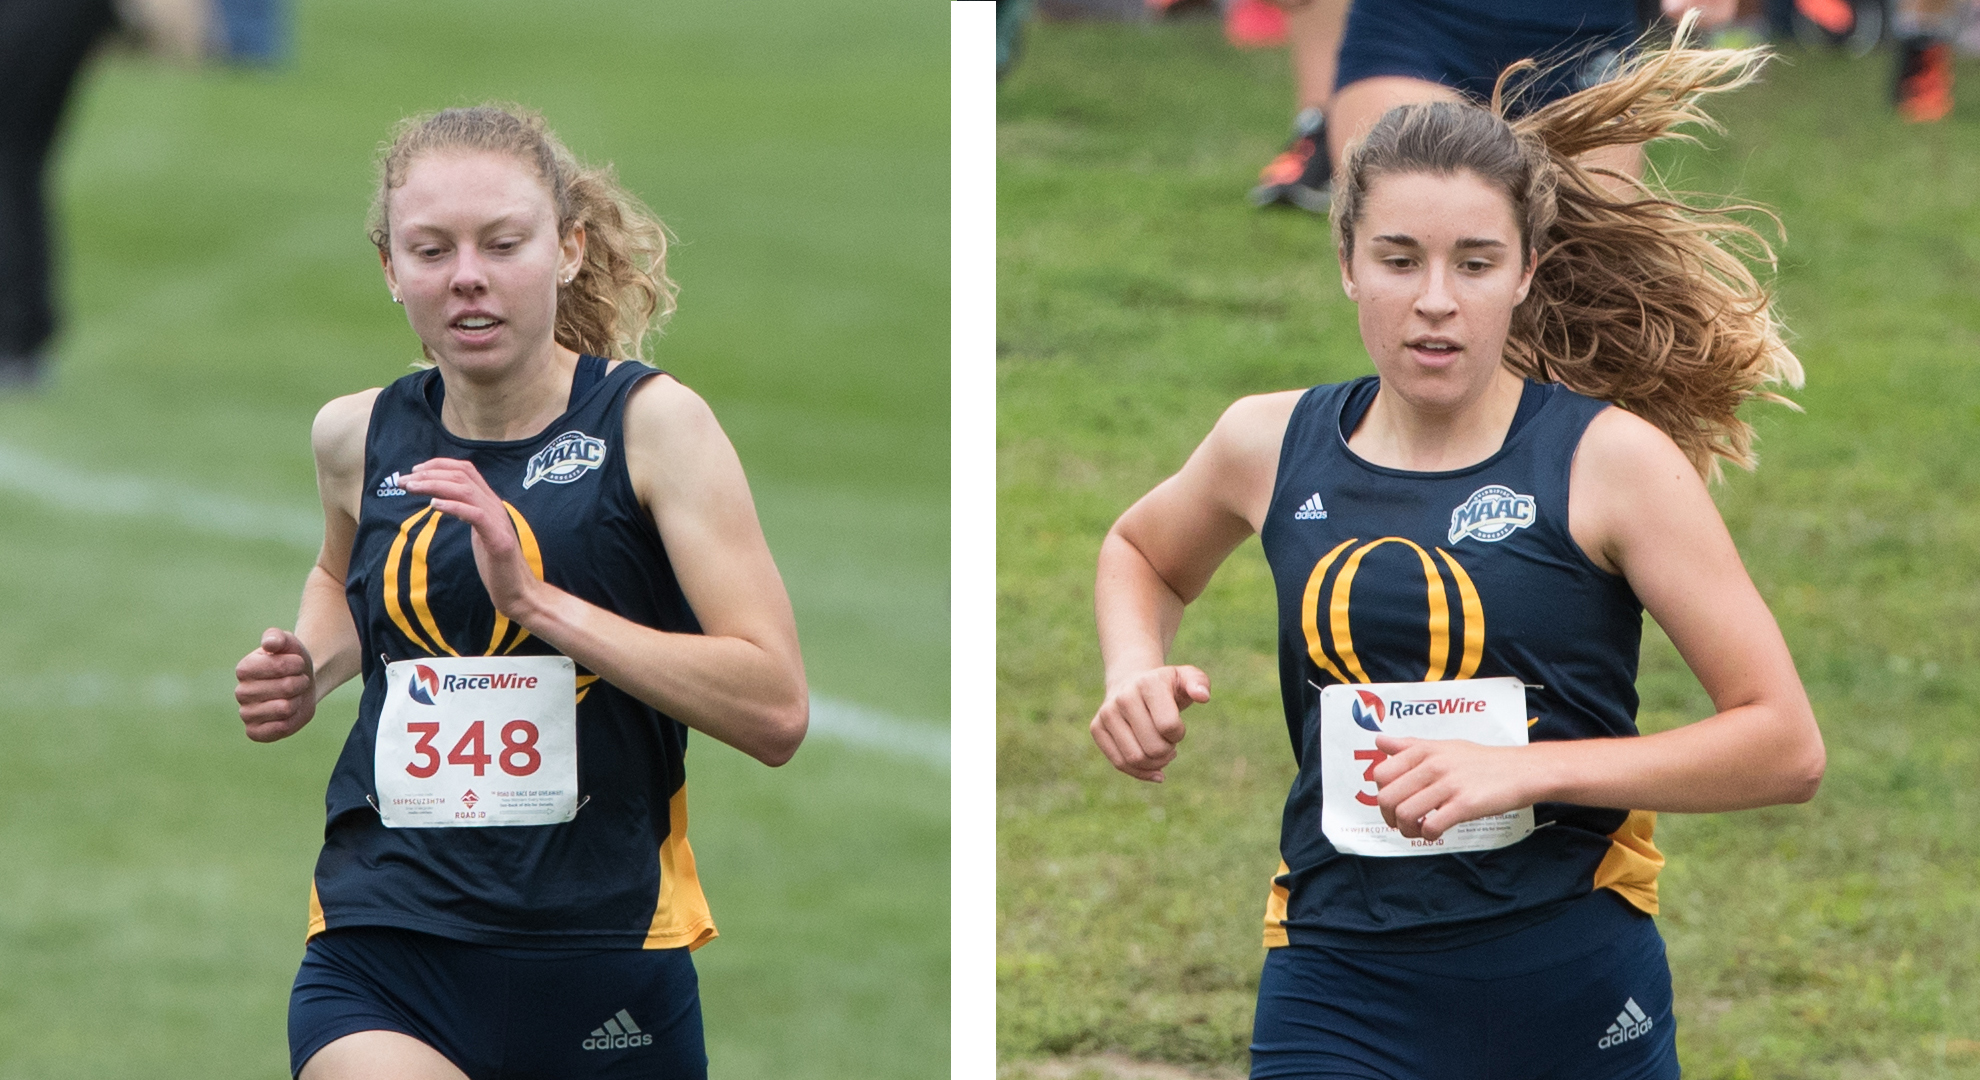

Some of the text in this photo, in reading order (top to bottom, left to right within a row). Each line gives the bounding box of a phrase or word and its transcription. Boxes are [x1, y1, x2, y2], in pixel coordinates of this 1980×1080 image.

[526, 439, 602, 484] MAAC
[376, 487, 407, 497] adidas
[1294, 509, 1328, 520] adidas
[1451, 498, 1531, 538] MAAC
[443, 673, 538, 692] RaceWire
[1389, 698, 1486, 719] RaceWire
[405, 719, 542, 779] 348
[455, 811, 476, 819] ROAD
[582, 1033, 653, 1050] adidas
[1598, 1016, 1653, 1049] adidas
